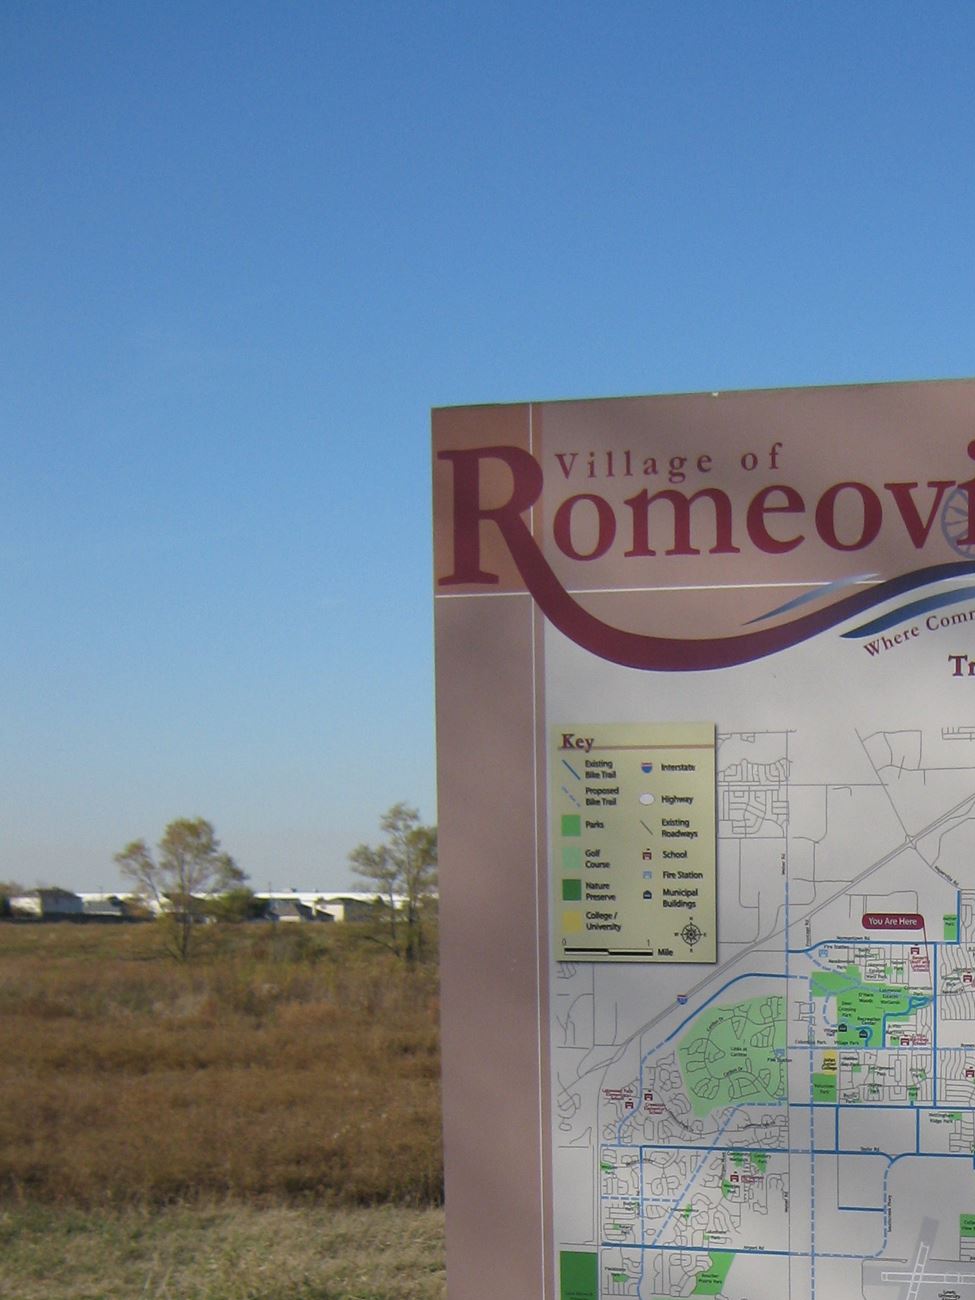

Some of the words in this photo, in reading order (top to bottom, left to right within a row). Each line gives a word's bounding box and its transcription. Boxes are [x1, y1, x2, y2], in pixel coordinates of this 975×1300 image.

[555, 448, 713, 483] Village
[741, 441, 785, 471] of
[863, 627, 921, 659] Where
[561, 733, 594, 753] Key
[585, 760, 613, 770] Existing
[661, 763, 696, 772] Interstate
[585, 771, 599, 780] Bike
[600, 771, 617, 780] Trail
[585, 786, 619, 796] Proposed
[585, 798, 599, 806] Bike
[600, 797, 617, 806] Trail
[661, 795, 694, 805] Highway
[585, 820, 604, 829] Parks
[661, 818, 690, 828] Existing
[661, 829, 698, 839] Roadways
[585, 849, 601, 858] Golf
[662, 850, 687, 859] School
[585, 860, 611, 869] Course
[662, 871, 676, 880] Fire
[677, 871, 703, 880] Station
[585, 881, 610, 890] Nature
[585, 893, 616, 902] Preserve
[662, 888, 698, 899] Municipal
[662, 900, 697, 909] Buildings
[586, 911, 612, 921] College
[868, 917, 883, 925] You
[884, 917, 898, 925] Are
[899, 918, 918, 926] Here
[586, 922, 622, 932] University
[658, 948, 673, 957] Mile
